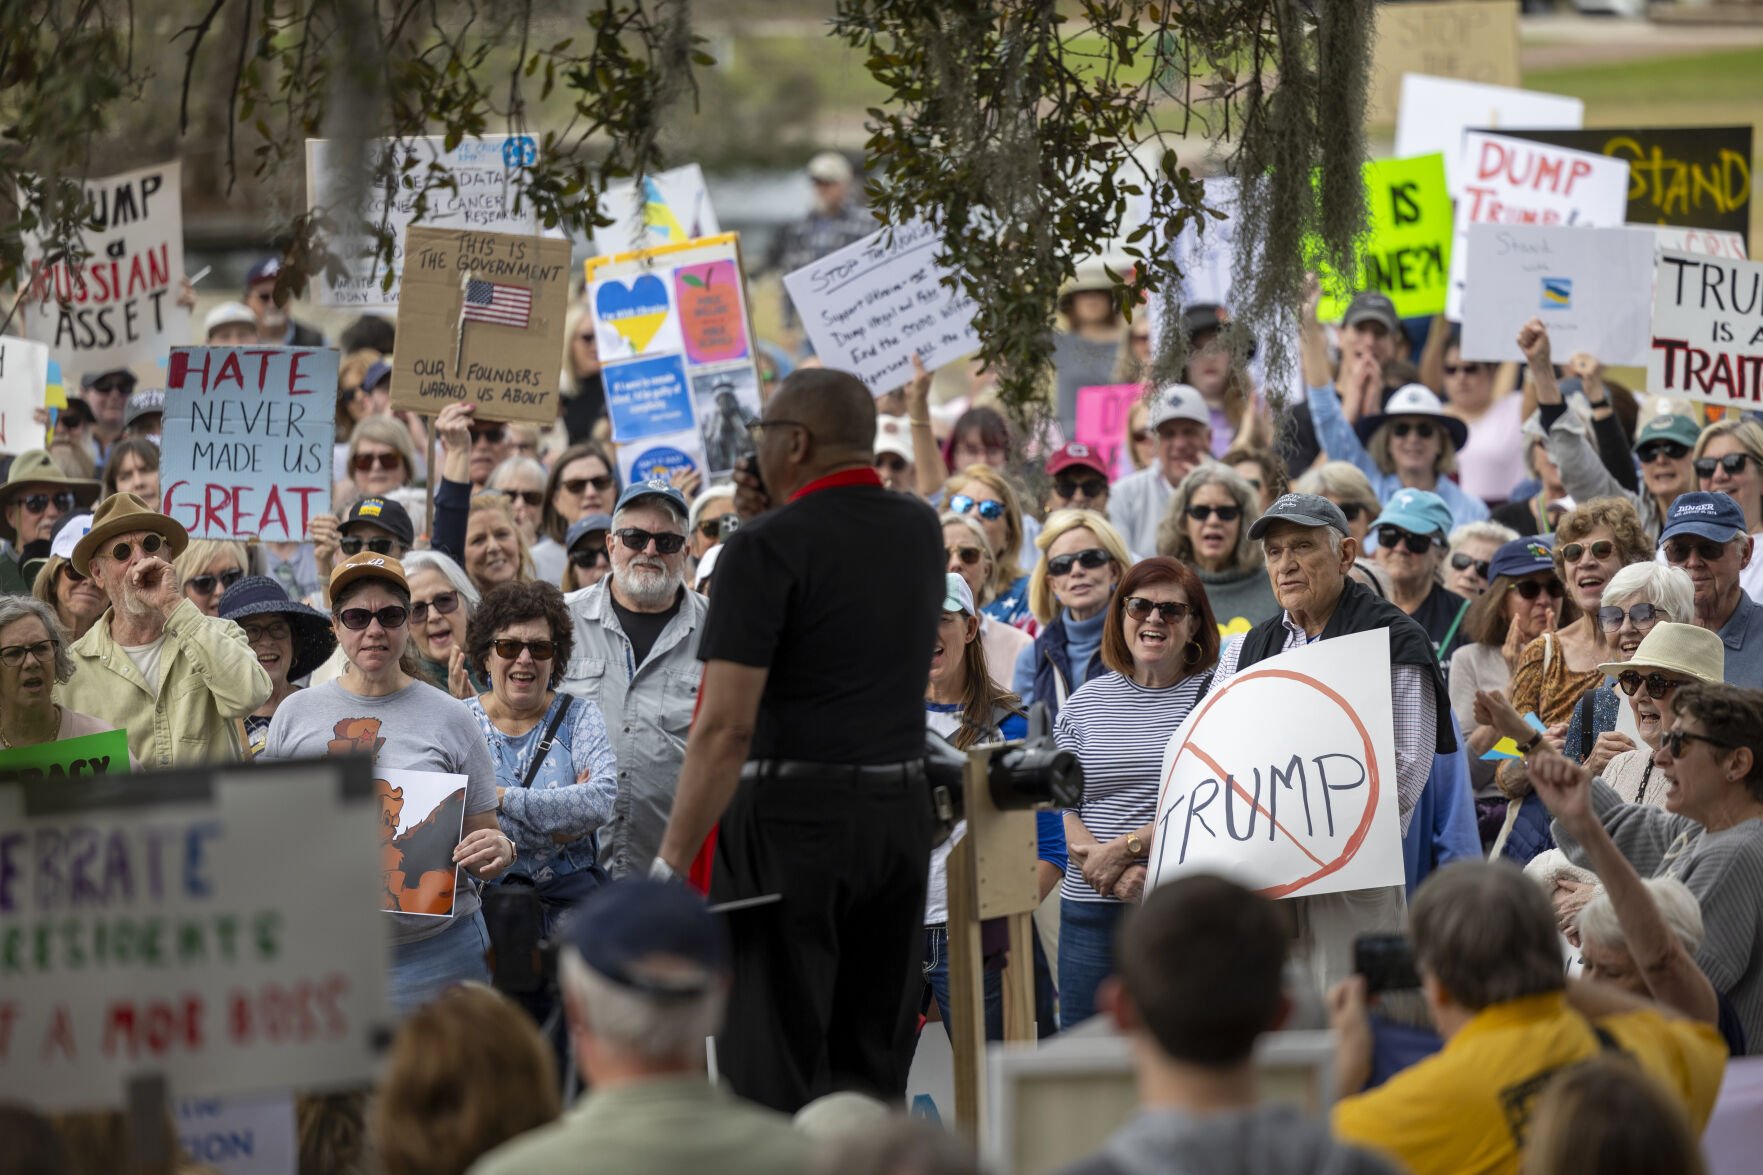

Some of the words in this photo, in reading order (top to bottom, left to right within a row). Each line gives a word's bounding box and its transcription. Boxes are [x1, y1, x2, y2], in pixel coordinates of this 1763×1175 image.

[1477, 139, 1594, 197] DUMP
[1390, 181, 1421, 227] IS
[420, 248, 447, 270] THE
[456, 253, 565, 283] GOVERNMENT
[454, 231, 496, 257] THIS
[509, 240, 527, 261] IS
[31, 243, 170, 305] RUSSIAN
[1662, 255, 1763, 317] TRU
[55, 290, 168, 349] ASSET
[1712, 320, 1735, 343] IS
[168, 351, 317, 397] HATE
[414, 359, 446, 380] OUR
[467, 362, 542, 387] FOUNDERS
[1652, 336, 1763, 401] TRAIT
[419, 380, 468, 401] WARNED
[477, 387, 494, 403] US
[502, 387, 550, 406] ABOUT
[191, 400, 306, 438] NEVER
[192, 442, 263, 473] MADE
[283, 442, 323, 474] US
[163, 480, 326, 538] GREAT
[1155, 753, 1366, 888] TRUMP
[39, 1001, 79, 1062] A
